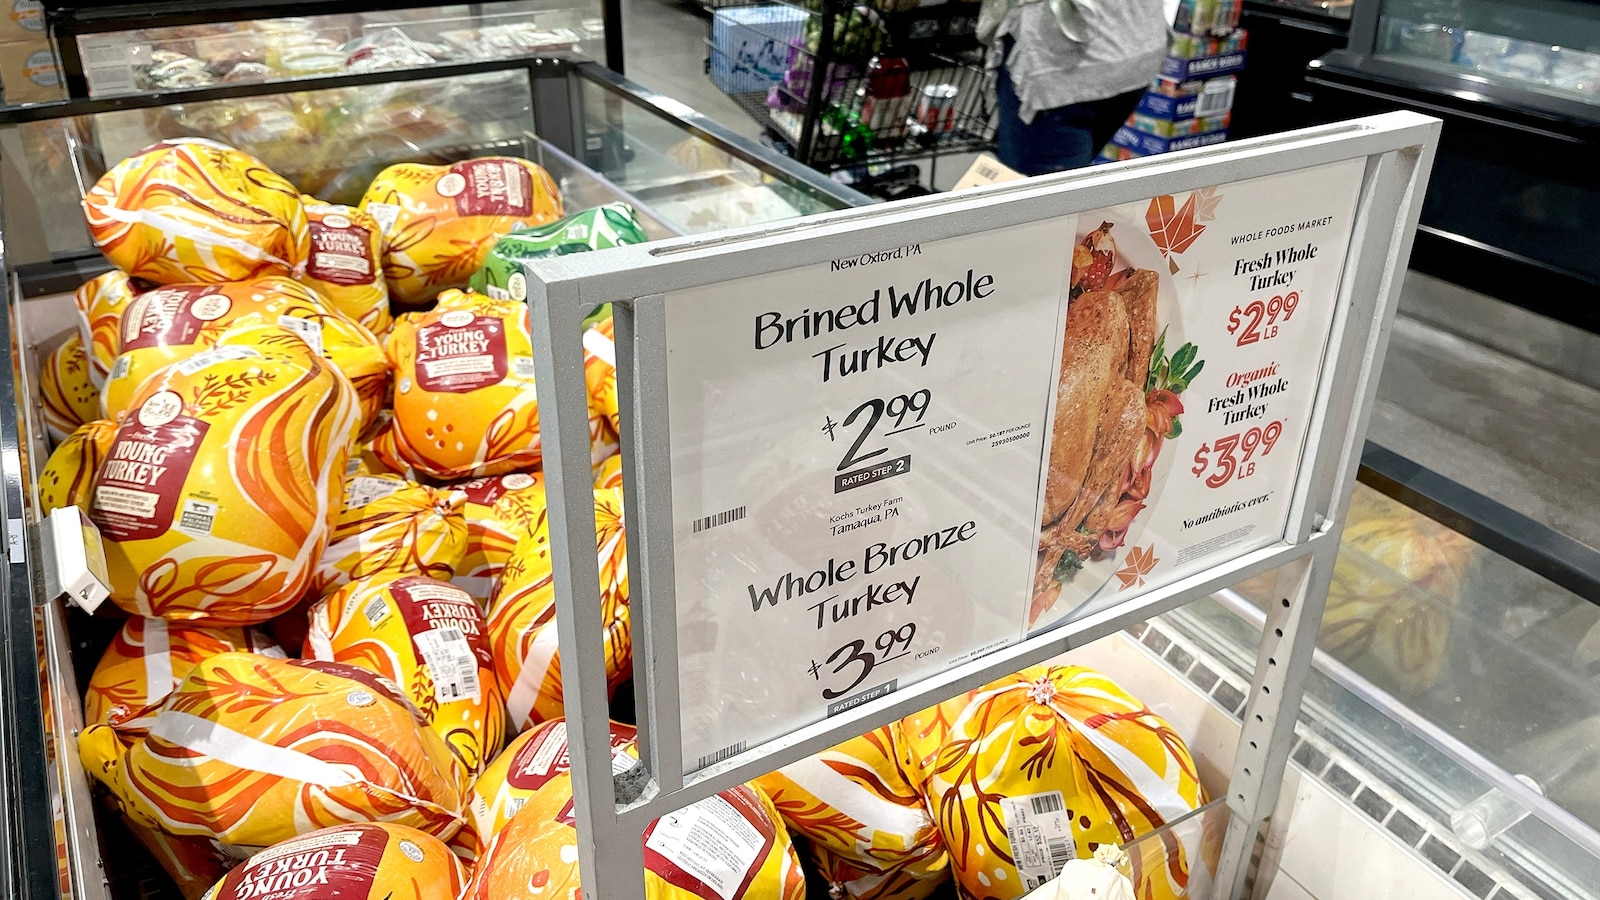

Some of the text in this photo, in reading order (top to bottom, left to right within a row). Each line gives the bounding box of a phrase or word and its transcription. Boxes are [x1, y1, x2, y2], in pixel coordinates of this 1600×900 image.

[1230, 216, 1333, 245] WHOLE FOODS MARKET
[831, 258, 859, 272] New
[906, 244, 921, 257] PA
[1233, 243, 1318, 276] Fresh Whole
[1250, 269, 1297, 292] Turkey
[754, 269, 995, 350] Brined Whole
[434, 330, 485, 347] YOUNG
[1263, 325, 1279, 340] LB
[430, 339, 490, 359] TURKEY
[811, 332, 937, 383] Turkey
[1225, 361, 1280, 388] Organic
[1207, 378, 1288, 414] Fresh Whole
[929, 421, 957, 435] POUND
[1015, 423, 1031, 431] OUNCE
[1223, 403, 1269, 426] Turkey
[114, 441, 168, 465] YOUNG
[102, 460, 168, 486] TURKEY
[841, 460, 905, 487] RATED STEP 2
[1237, 462, 1256, 480] LB
[829, 496, 903, 524] Kochs Turkey Farm
[830, 506, 899, 536] Tamaqua, PA
[1179, 493, 1269, 532] No antibiotics ever.
[747, 519, 978, 612] Whole Bronze
[422, 602, 480, 622] TURKEY
[807, 575, 921, 630] Turkey
[914, 646, 940, 660] POUND
[833, 683, 891, 713] RATED STEP 1
[234, 848, 347, 891] TURKEY
[236, 865, 329, 900] YOUNG
